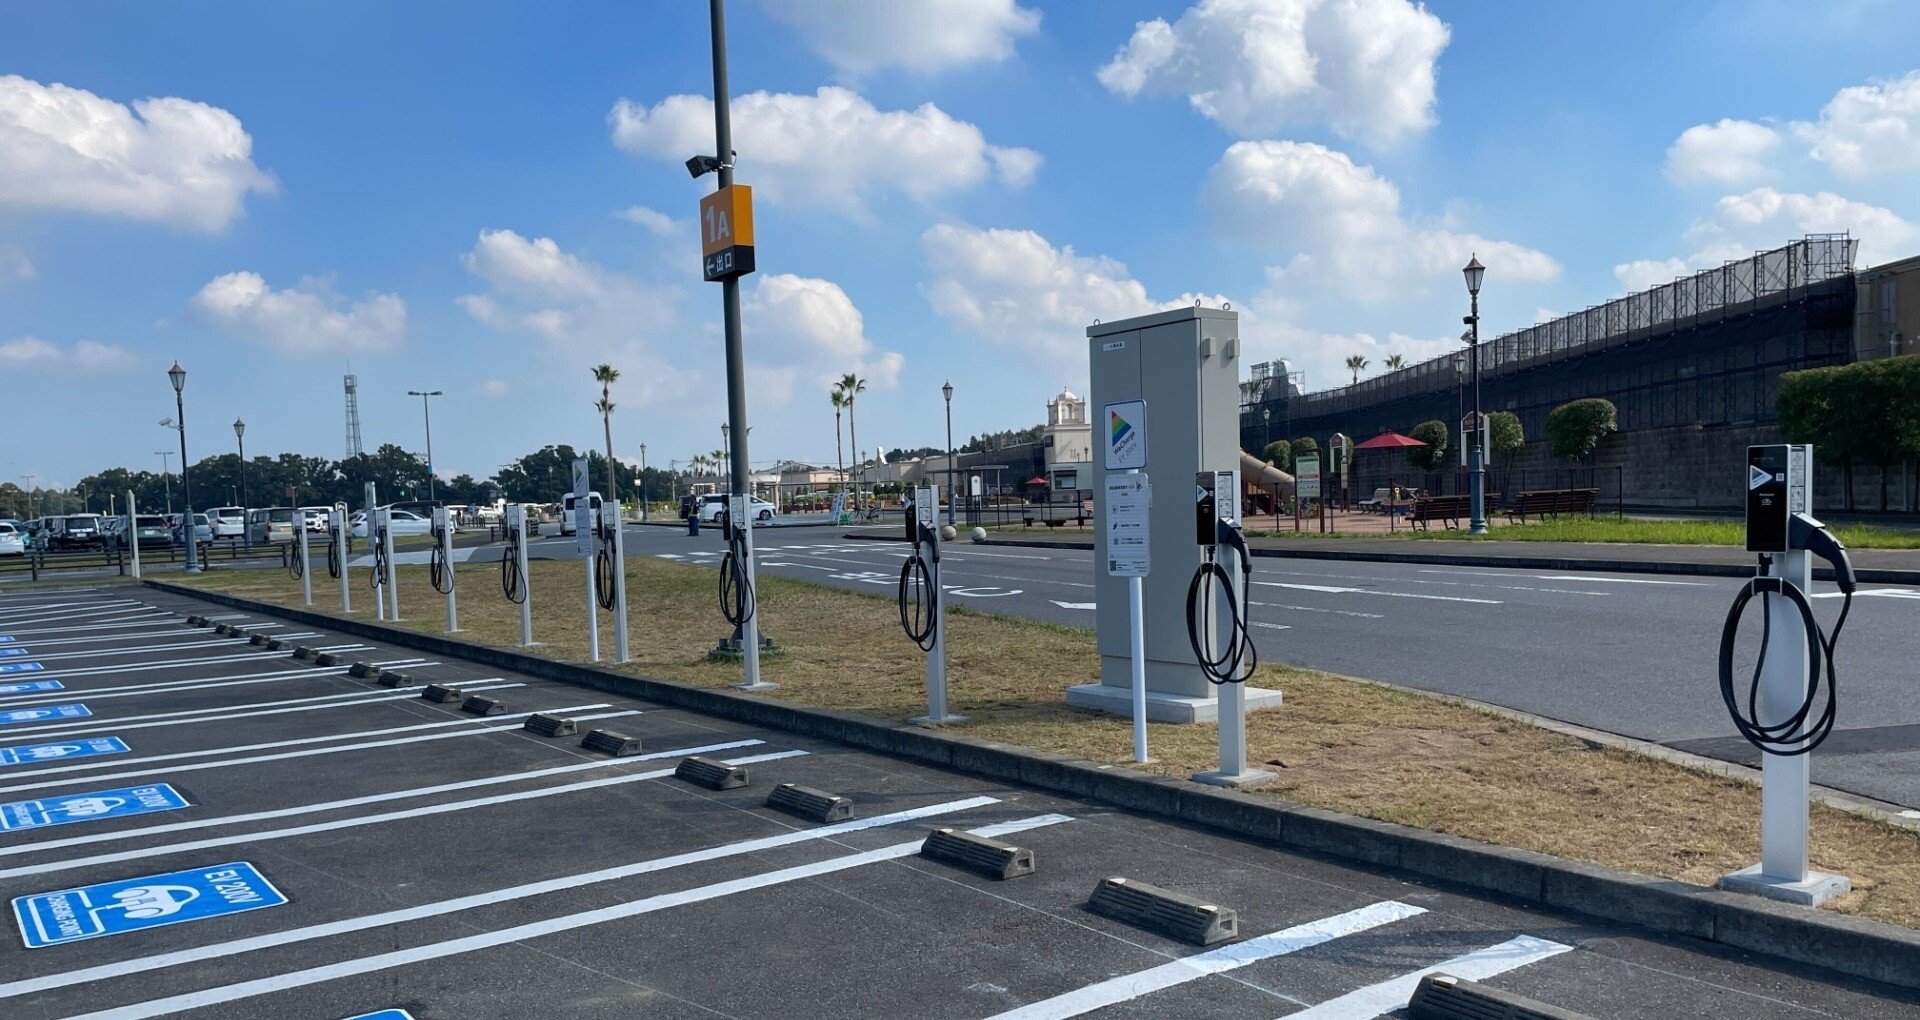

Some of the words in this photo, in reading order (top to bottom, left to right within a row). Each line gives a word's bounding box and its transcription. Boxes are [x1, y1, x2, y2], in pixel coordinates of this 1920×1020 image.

[706, 205, 729, 242] 1A
[716, 252, 732, 273] 出口
[204, 869, 242, 882] EV
[215, 881, 263, 904] 200V
